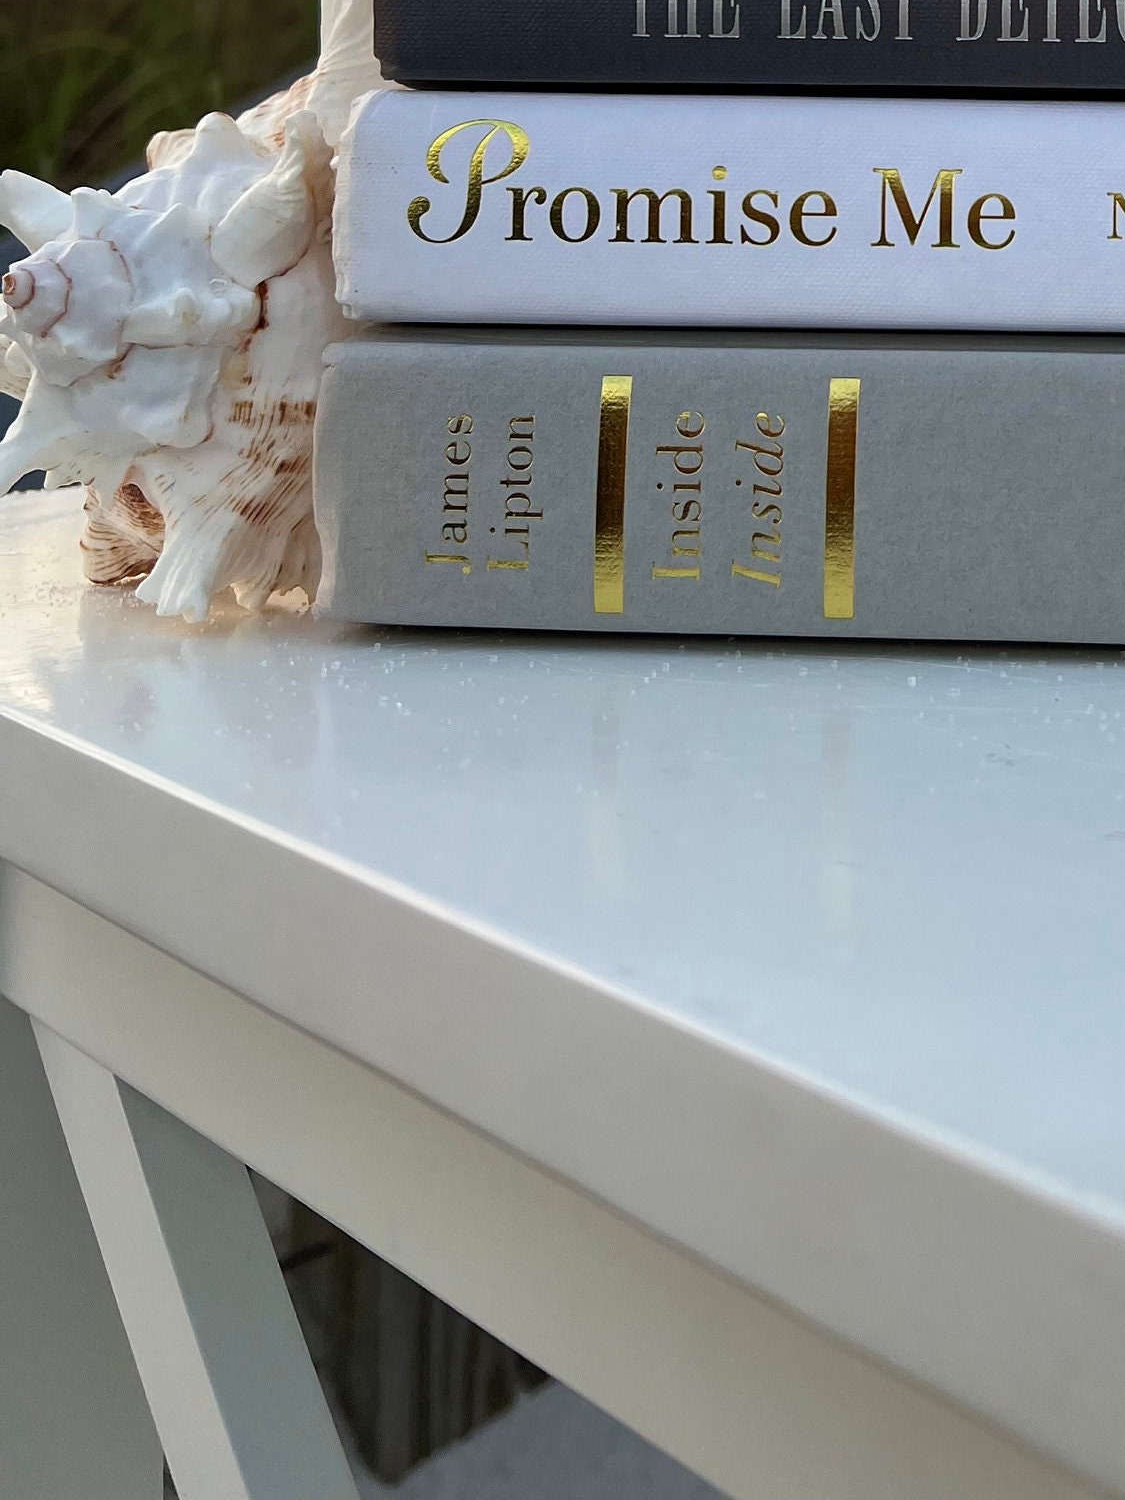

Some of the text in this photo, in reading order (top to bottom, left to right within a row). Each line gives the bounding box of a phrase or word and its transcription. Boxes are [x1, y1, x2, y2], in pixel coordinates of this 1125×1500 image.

[407, 118, 1018, 249] Promise Me
[423, 413, 474, 574] James
[486, 414, 544, 572] Lipton
[651, 410, 706, 580] Inside
[731, 411, 786, 588] Inside
